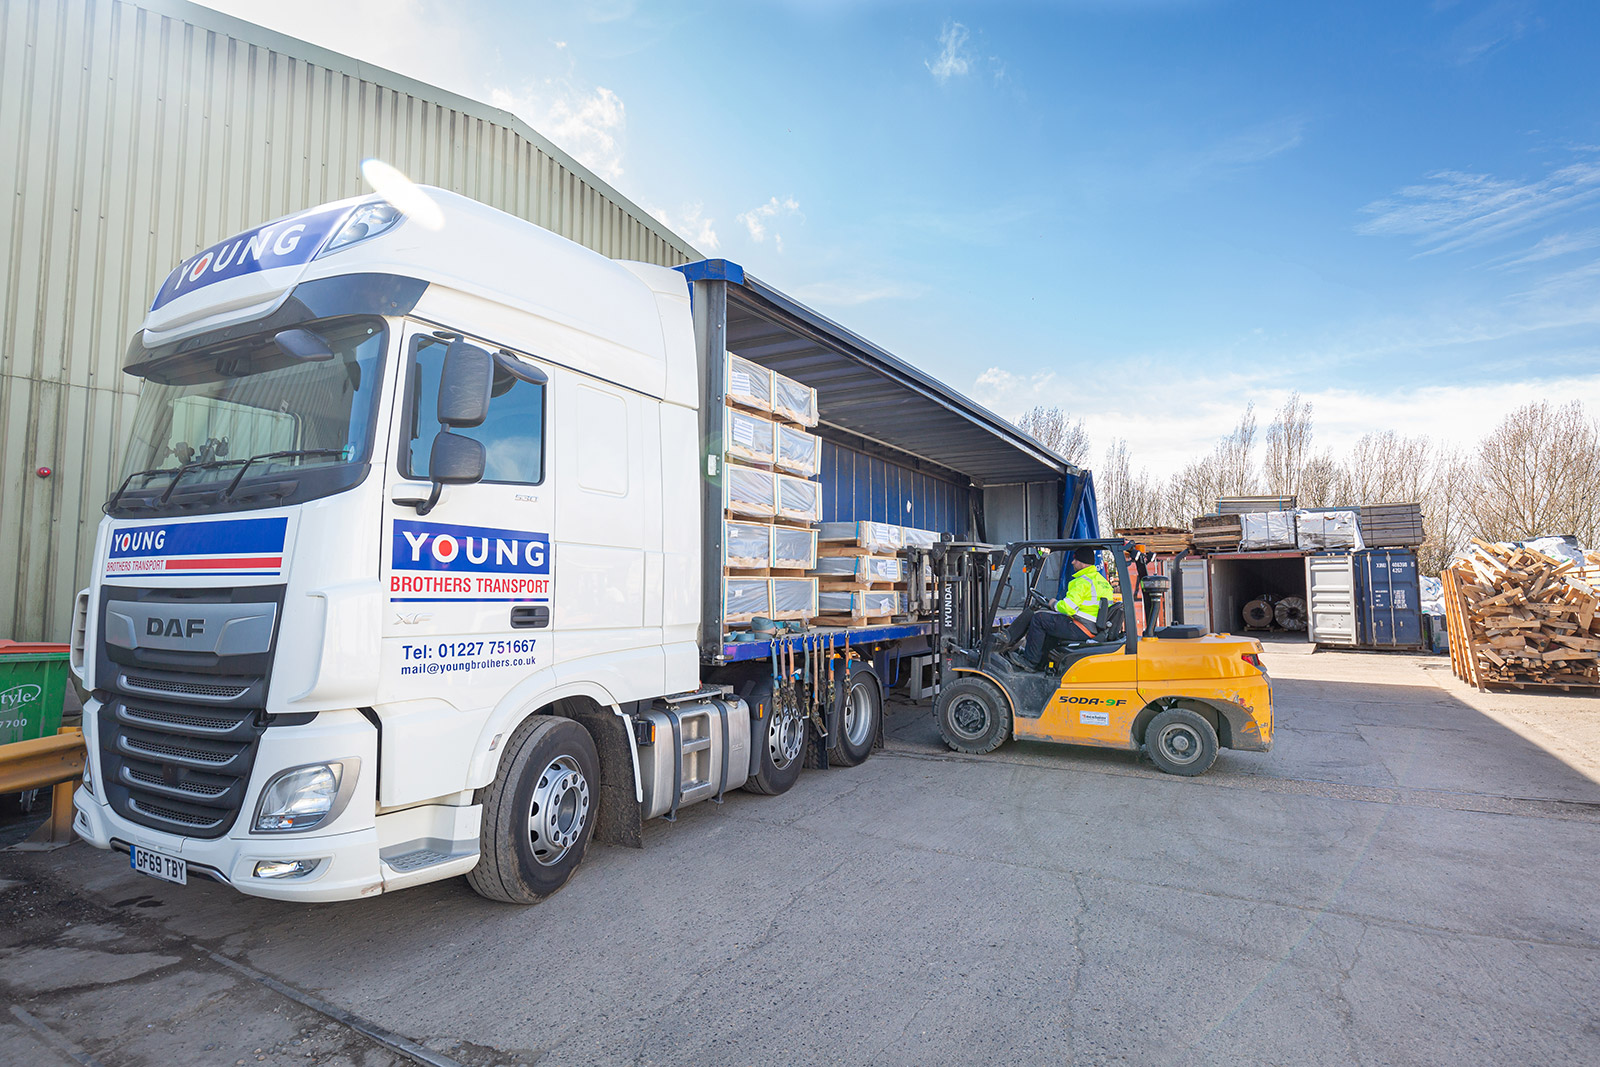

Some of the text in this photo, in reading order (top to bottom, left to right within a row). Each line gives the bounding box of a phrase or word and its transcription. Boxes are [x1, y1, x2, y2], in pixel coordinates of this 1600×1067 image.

[175, 223, 306, 291] YOUNG
[114, 530, 166, 552] YOUNG
[402, 531, 545, 567] YOUNG
[106, 559, 165, 571] BROTHERS TRANSPORT
[390, 576, 550, 594] BROTHERS TRANSPORT
[944, 583, 953, 628] HYUNDAI
[146, 617, 206, 639] DAF
[402, 639, 537, 660] Tel: 01227 751667
[401, 656, 537, 675] mail@youngbrothers.co.uk
[136, 850, 184, 880] GF69 TBY
